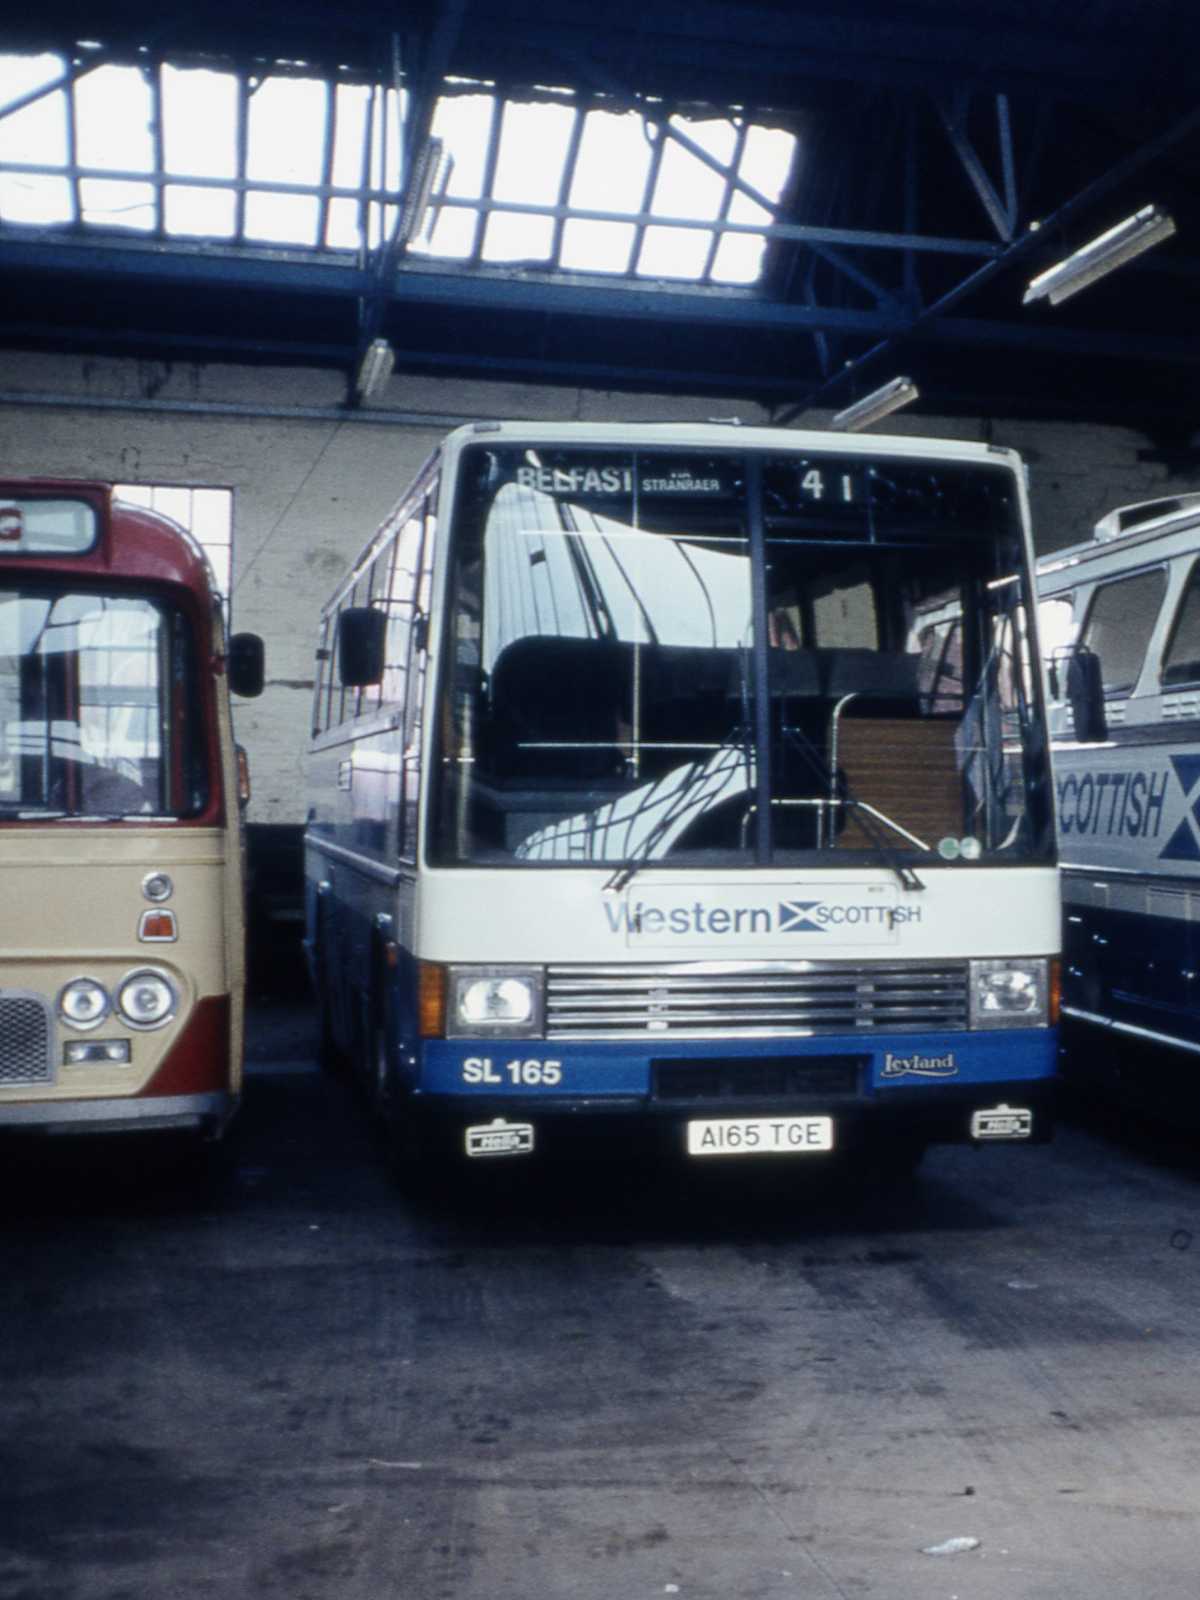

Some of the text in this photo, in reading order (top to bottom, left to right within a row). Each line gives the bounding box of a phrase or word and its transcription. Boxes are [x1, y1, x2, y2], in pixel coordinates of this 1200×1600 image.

[517, 467, 633, 493] BELFAST
[642, 479, 720, 492] STRANRAER
[1057, 771, 1169, 837] COTTISH
[603, 901, 922, 933] Western SCOTTSH
[463, 1057, 562, 1083] SL 165
[881, 1053, 957, 1077] Leyland
